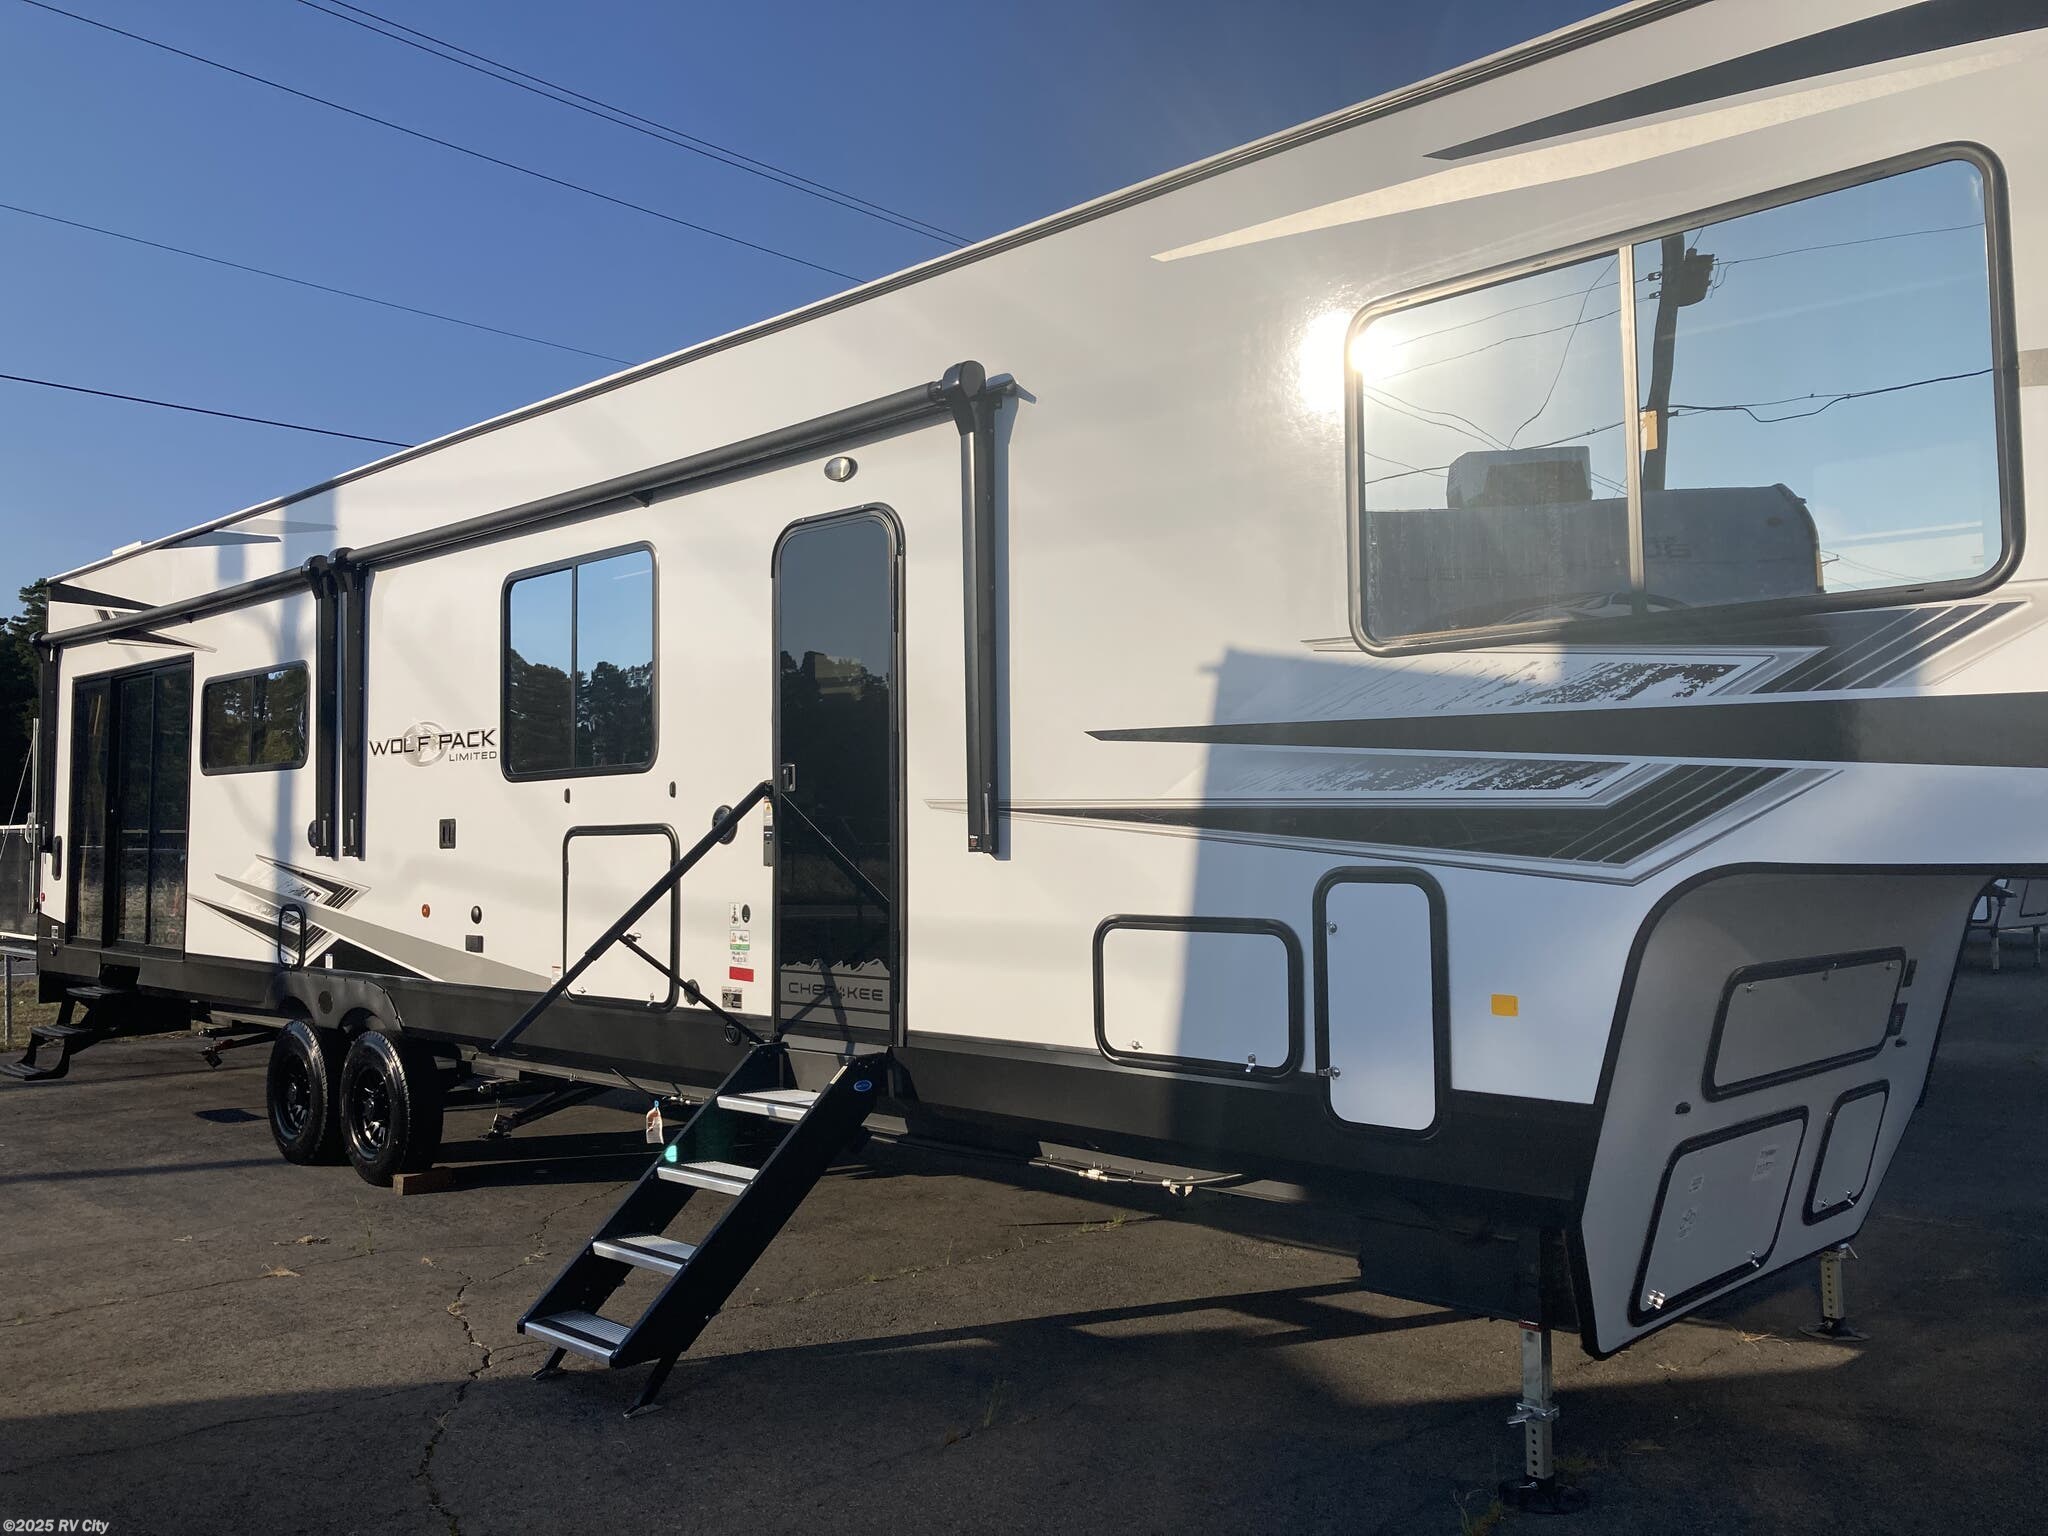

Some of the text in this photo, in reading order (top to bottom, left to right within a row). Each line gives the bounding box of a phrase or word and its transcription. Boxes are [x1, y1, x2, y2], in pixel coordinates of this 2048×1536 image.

[369, 729, 497, 756] WOLF PACK
[448, 751, 497, 762] LIMITED
